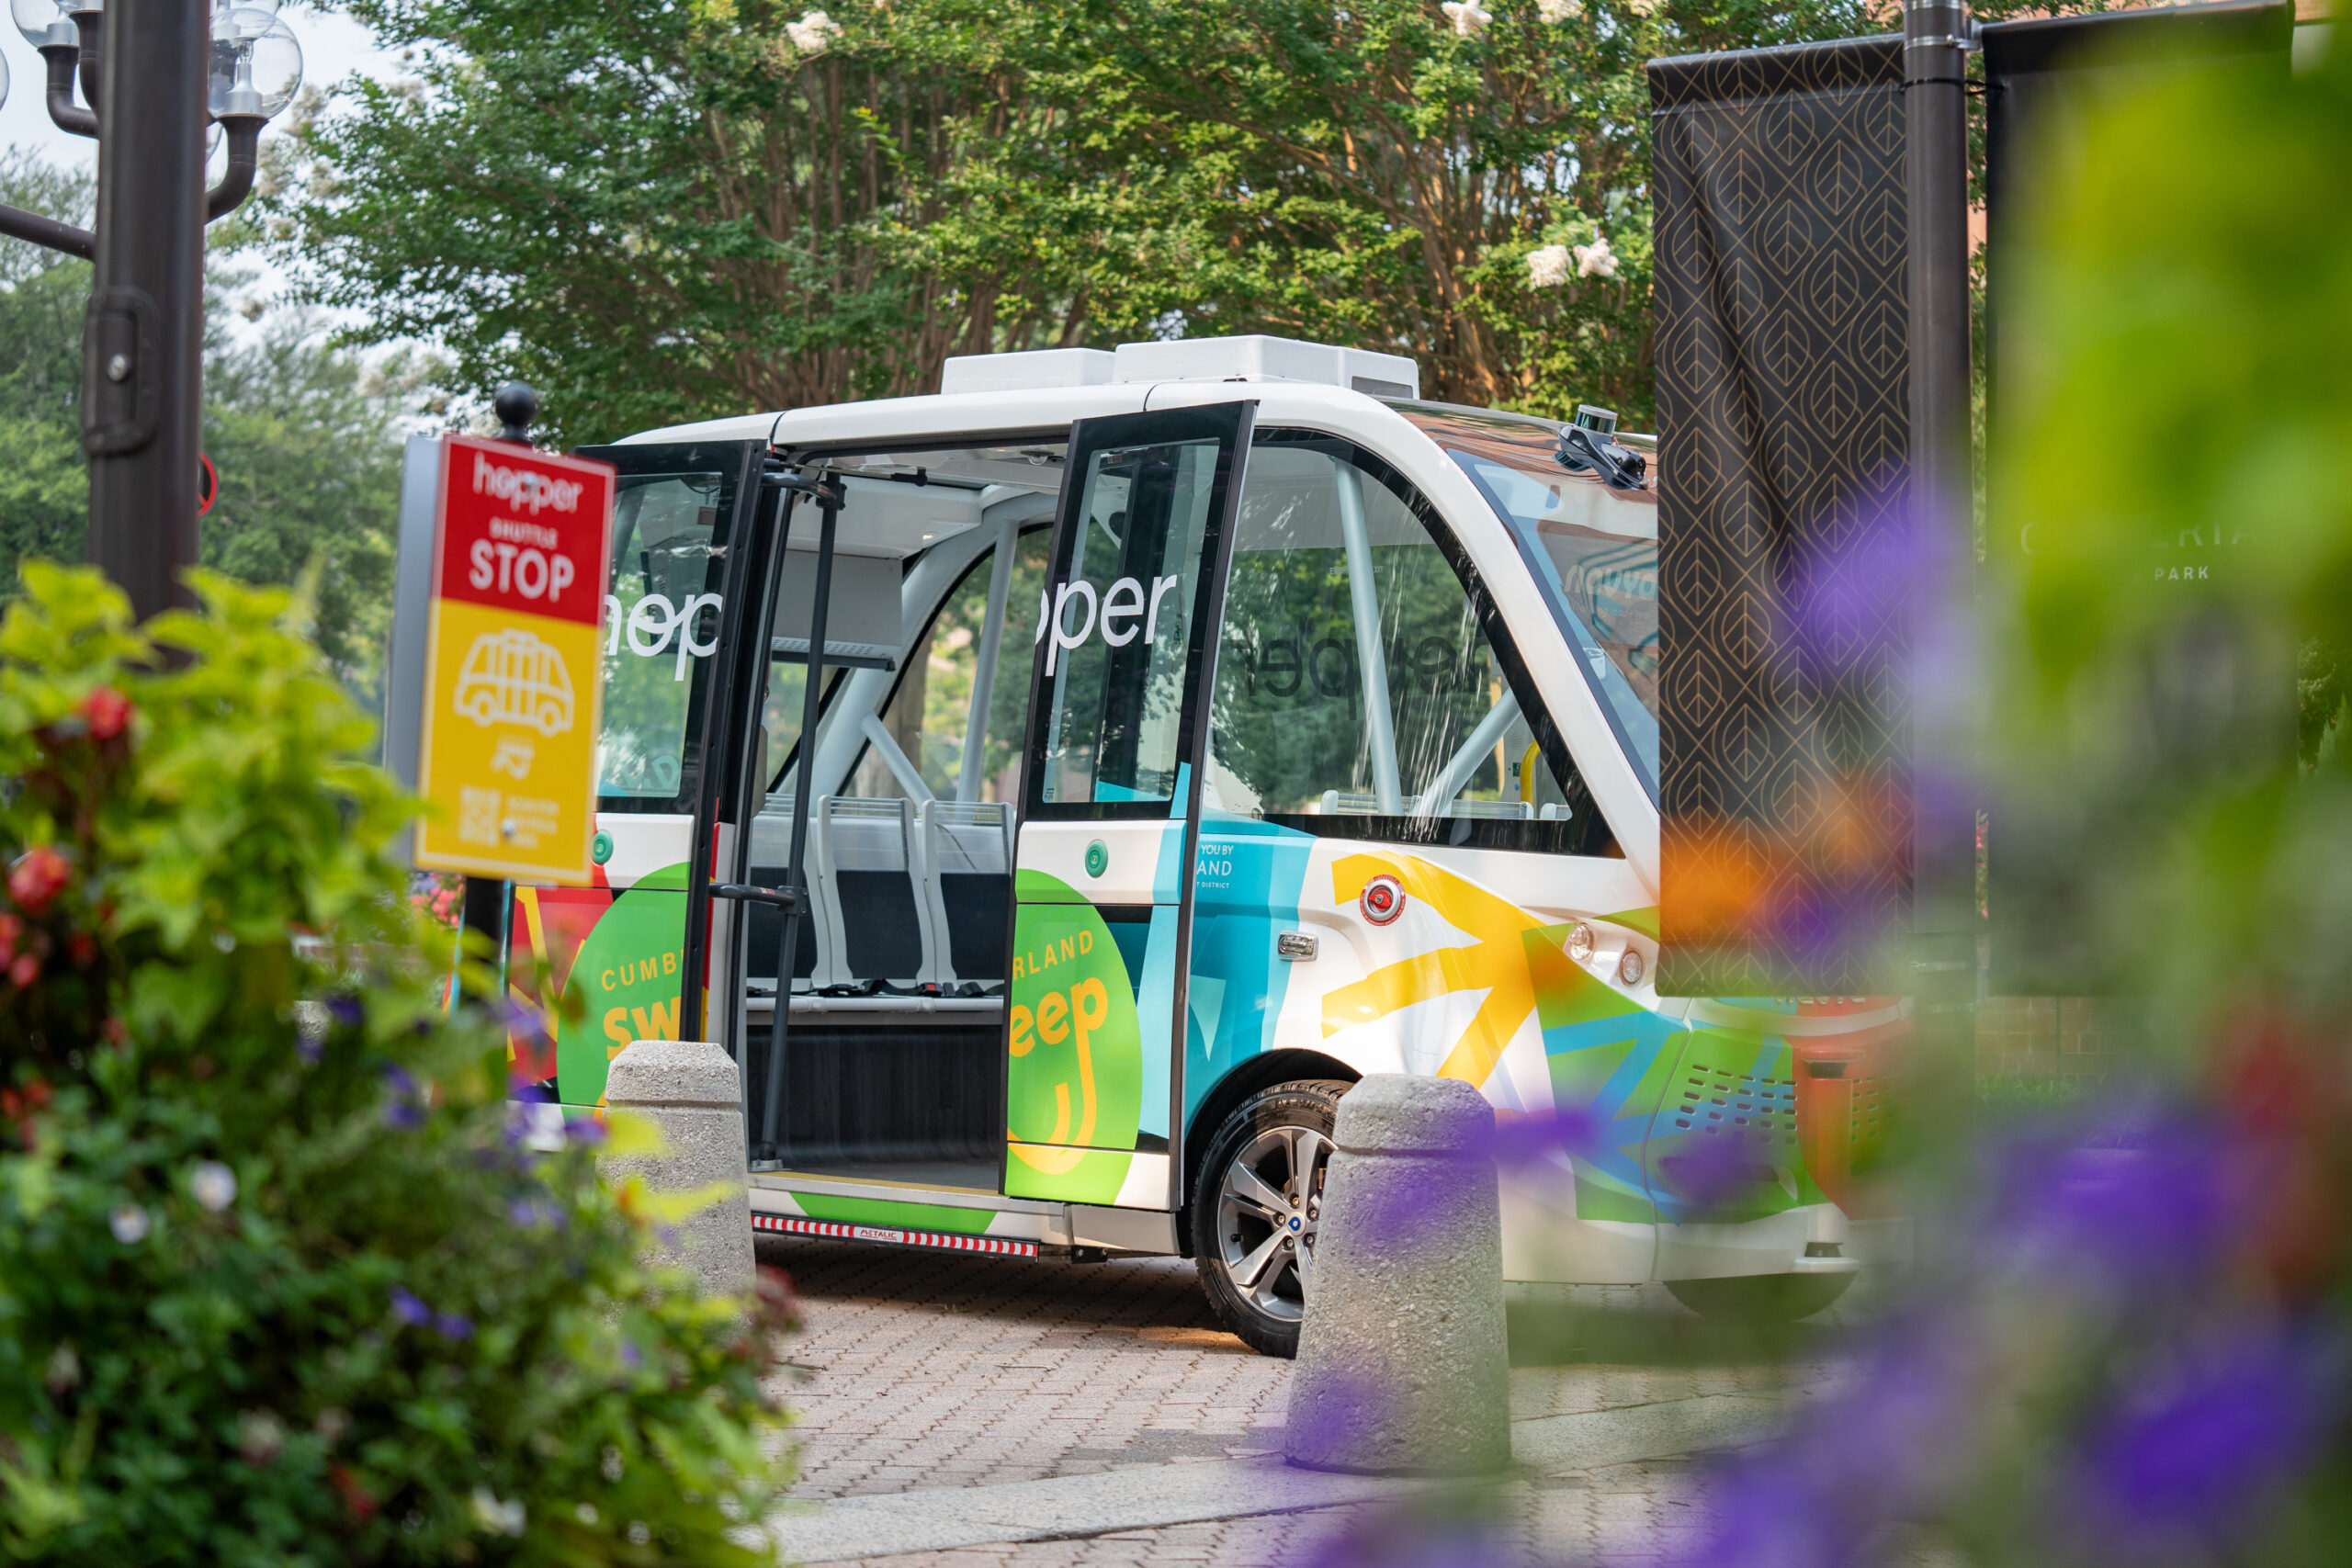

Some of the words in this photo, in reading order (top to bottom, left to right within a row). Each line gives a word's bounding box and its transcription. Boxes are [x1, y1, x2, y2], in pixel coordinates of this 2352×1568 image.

[472, 451, 584, 516] hopper
[469, 538, 575, 603] STOP
[2154, 565, 2211, 581] PARK
[1035, 574, 1178, 677] per
[1196, 860, 1232, 876] AND
[1201, 844, 1220, 855] YOU
[1222, 845, 1234, 855] BY
[1201, 881, 1230, 889] DISTRICT
[601, 947, 684, 991] CUMB
[1012, 930, 1094, 981] RLAND
[603, 996, 682, 1062] SW
[860, 1228, 898, 1240] METALIC
